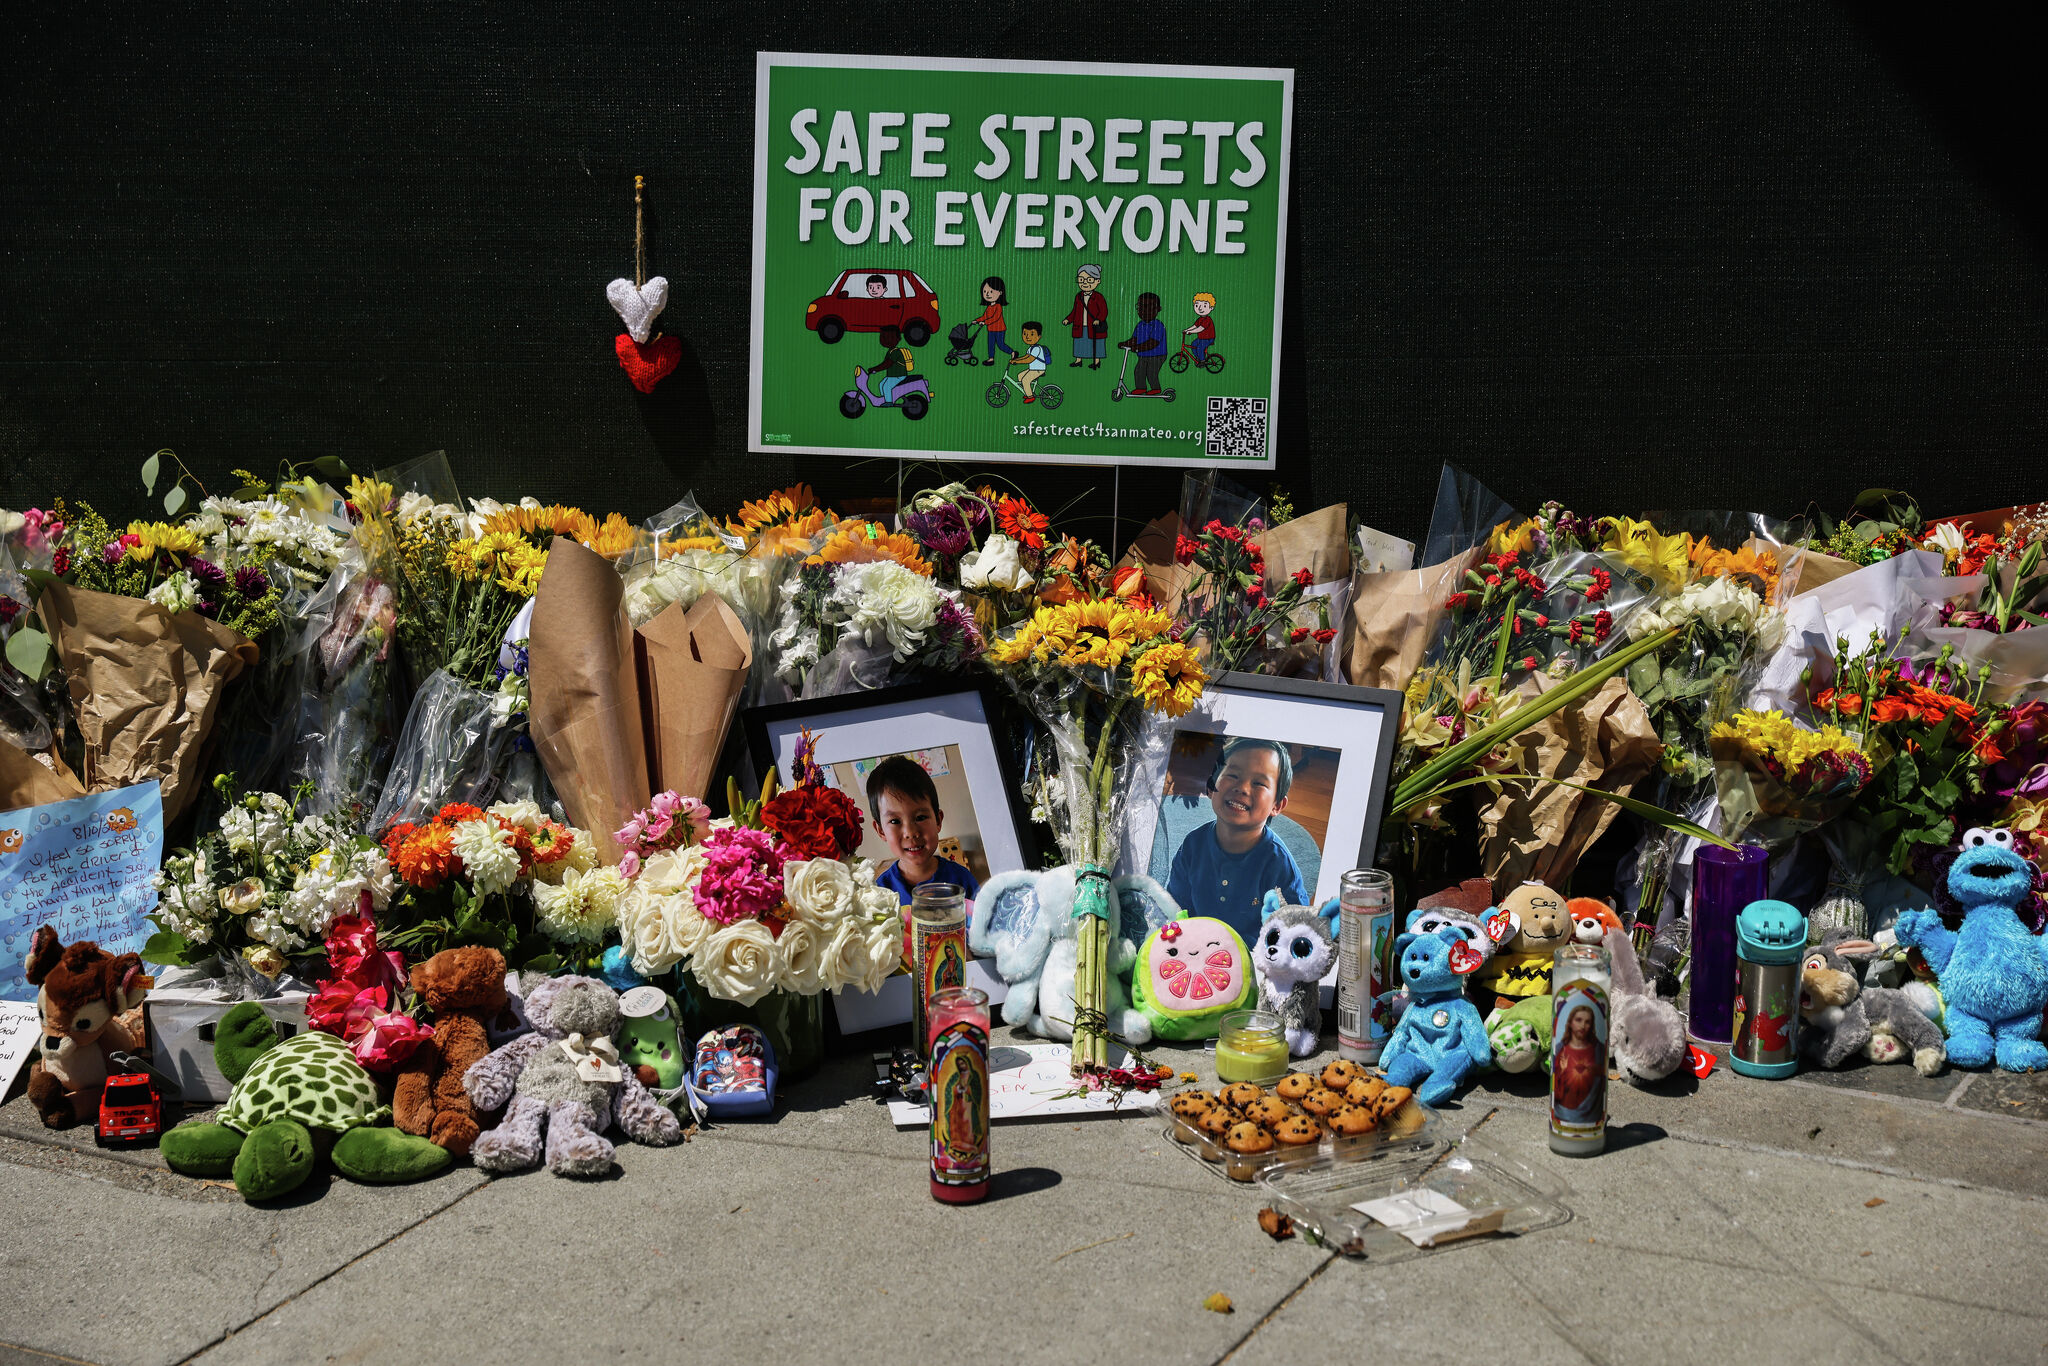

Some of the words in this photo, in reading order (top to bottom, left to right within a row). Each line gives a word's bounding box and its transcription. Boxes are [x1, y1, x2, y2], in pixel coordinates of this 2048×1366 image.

[785, 108, 950, 177] SAFE
[974, 114, 1266, 187] STREETS
[799, 186, 913, 245] FOR
[934, 191, 1249, 254] EVERYONE
[1013, 421, 1203, 446] safestreets4sanmateo.org
[48, 847, 71, 869] feel
[76, 845, 94, 856] so
[72, 883, 106, 898] thing
[22, 913, 34, 927] I
[92, 892, 117, 909] bad
[1489, 920, 1506, 940] ty
